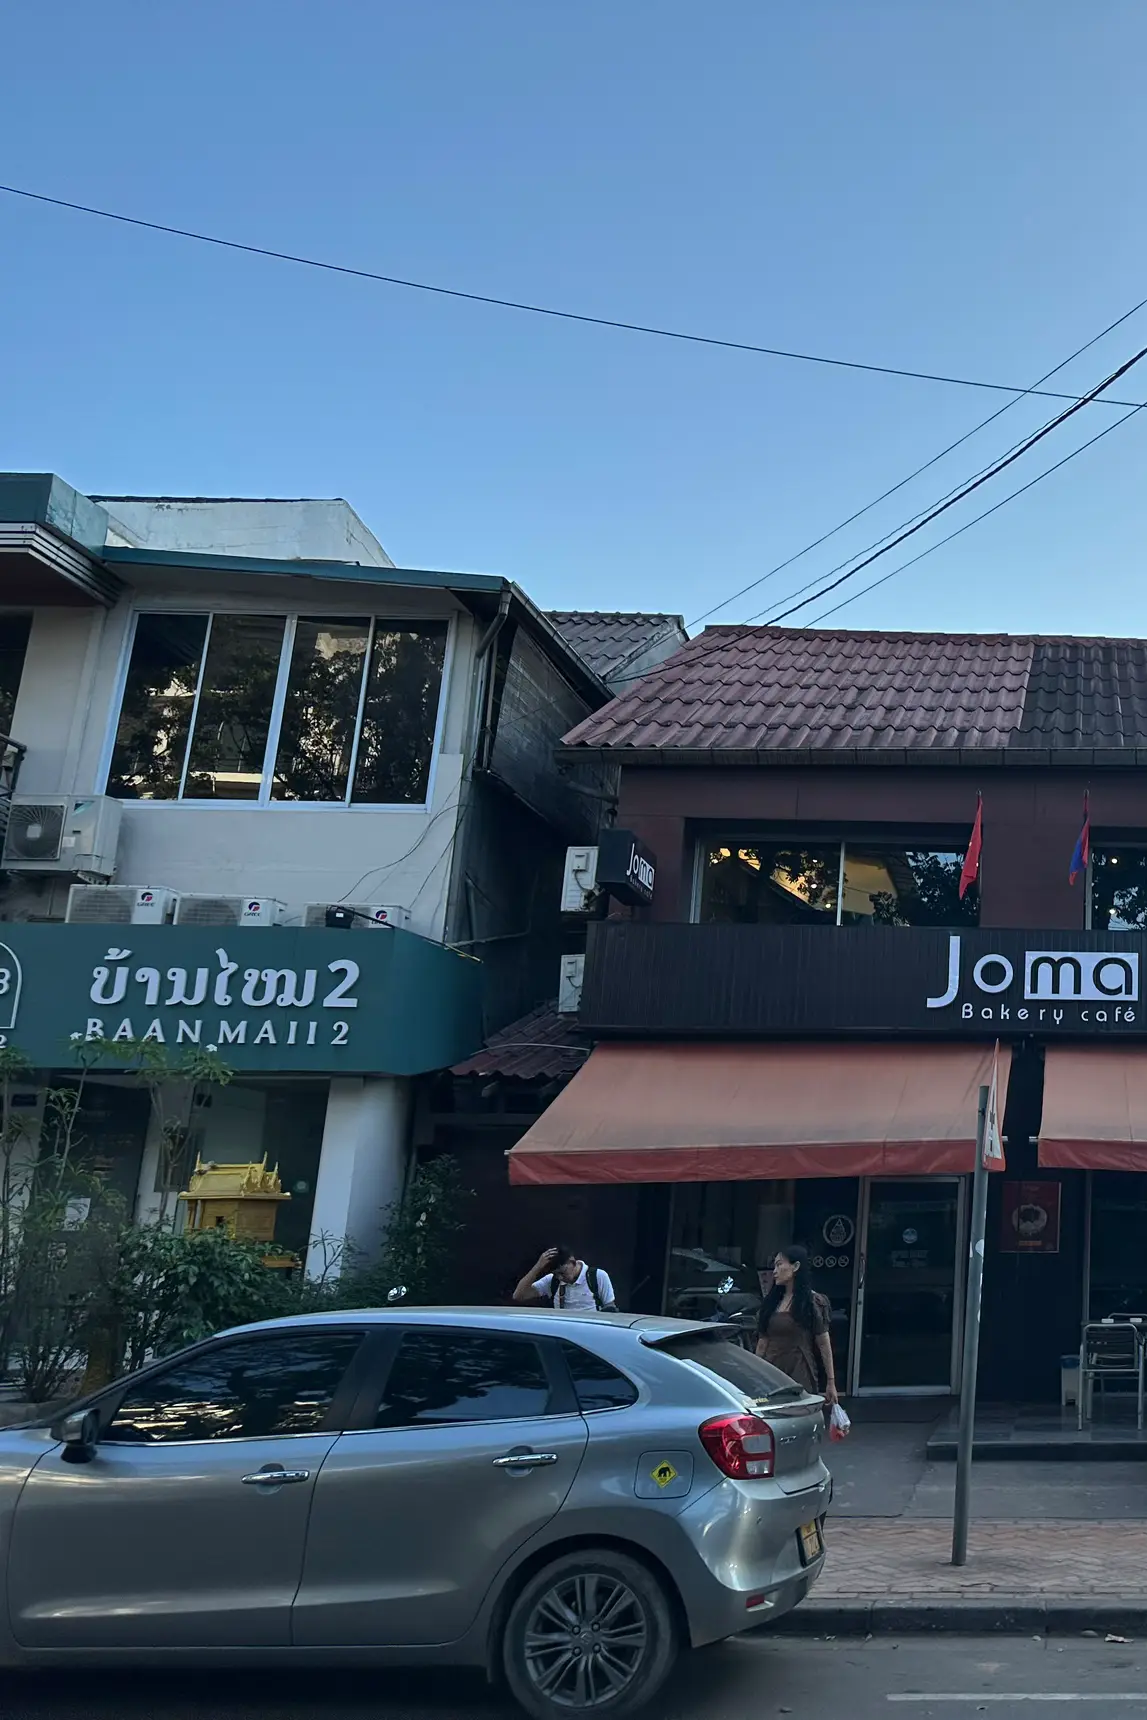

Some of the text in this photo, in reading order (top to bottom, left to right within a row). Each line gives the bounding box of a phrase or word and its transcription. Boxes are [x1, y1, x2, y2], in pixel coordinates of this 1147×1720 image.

[627, 843, 655, 891] Joma
[927, 935, 1138, 1008] Joma
[85, 1018, 350, 1045] BAAN MAII 2
[961, 1003, 1136, 1024] Bakery café
